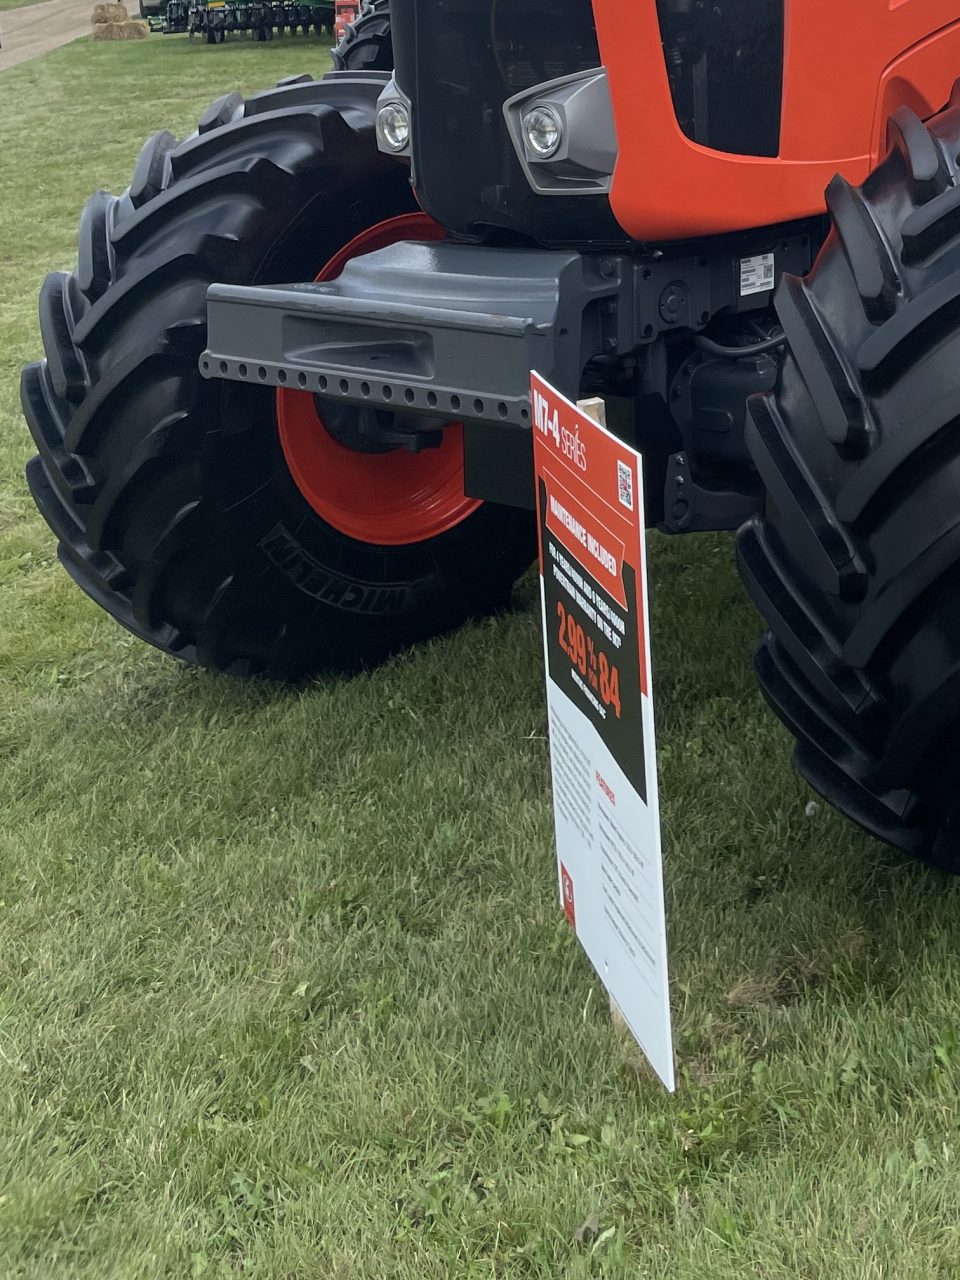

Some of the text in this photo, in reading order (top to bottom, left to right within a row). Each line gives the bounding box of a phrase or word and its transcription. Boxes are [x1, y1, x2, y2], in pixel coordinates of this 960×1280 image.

[534, 389, 560, 448] M7-4
[549, 494, 617, 577] MAINTENANCE INCLUDED
[599, 648, 621, 718] 84
